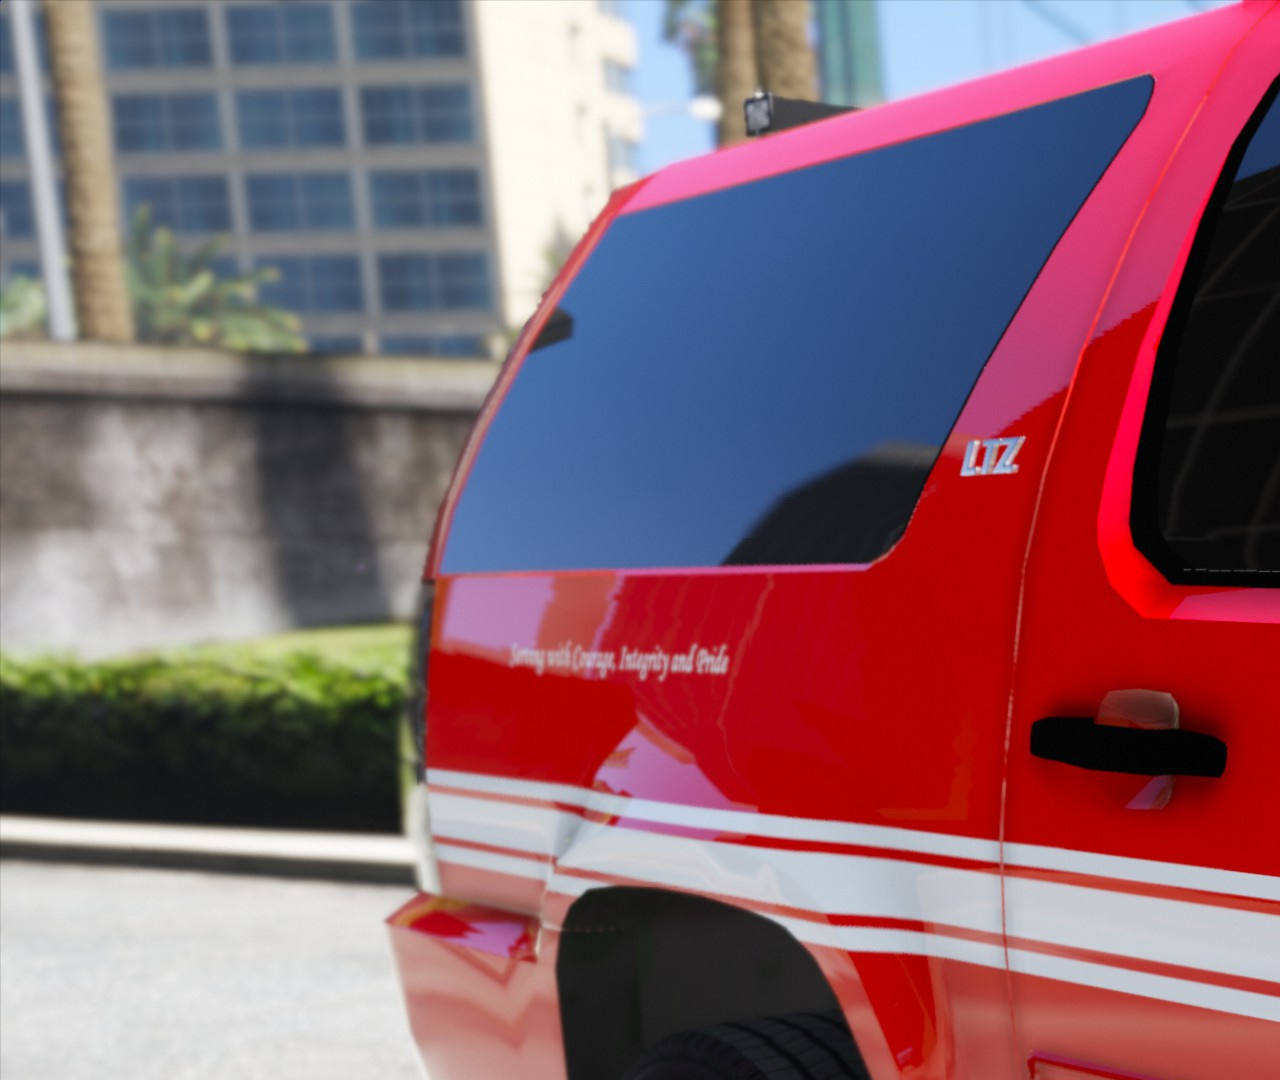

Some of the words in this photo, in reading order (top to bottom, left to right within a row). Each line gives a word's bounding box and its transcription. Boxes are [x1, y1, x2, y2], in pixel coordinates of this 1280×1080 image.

[960, 435, 1026, 477] LTZ
[619, 645, 669, 682] Integrity
[671, 643, 698, 673] and
[696, 644, 729, 675] Pride
